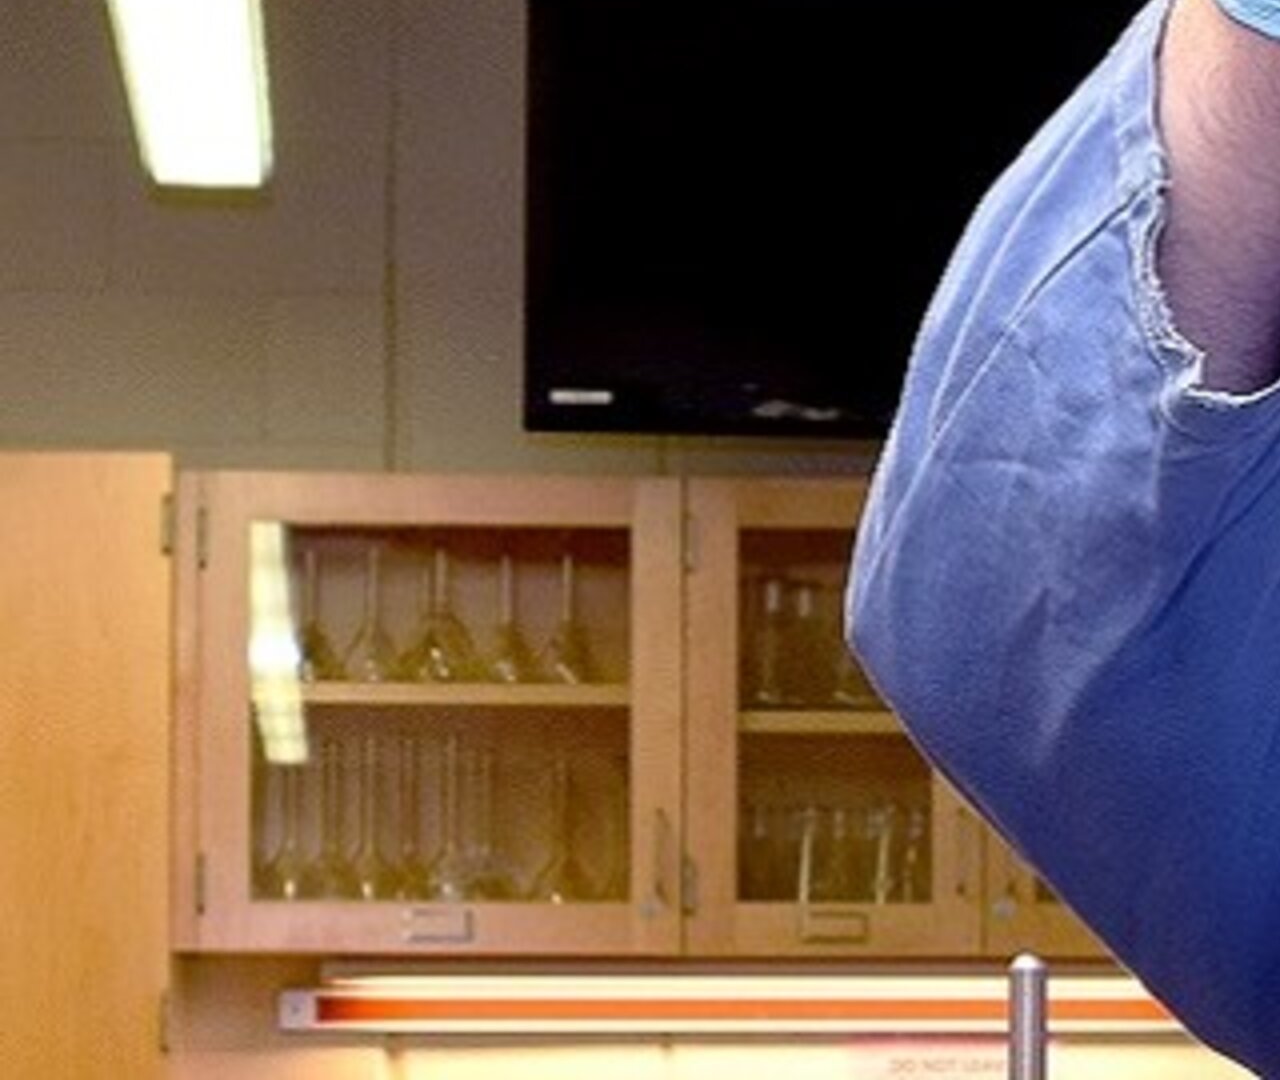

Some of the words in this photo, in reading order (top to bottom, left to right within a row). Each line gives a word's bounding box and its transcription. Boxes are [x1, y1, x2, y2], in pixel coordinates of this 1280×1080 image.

[889, 1059, 916, 1074] DO
[922, 1059, 957, 1074] NOT
[962, 1059, 1005, 1074] LEAV
